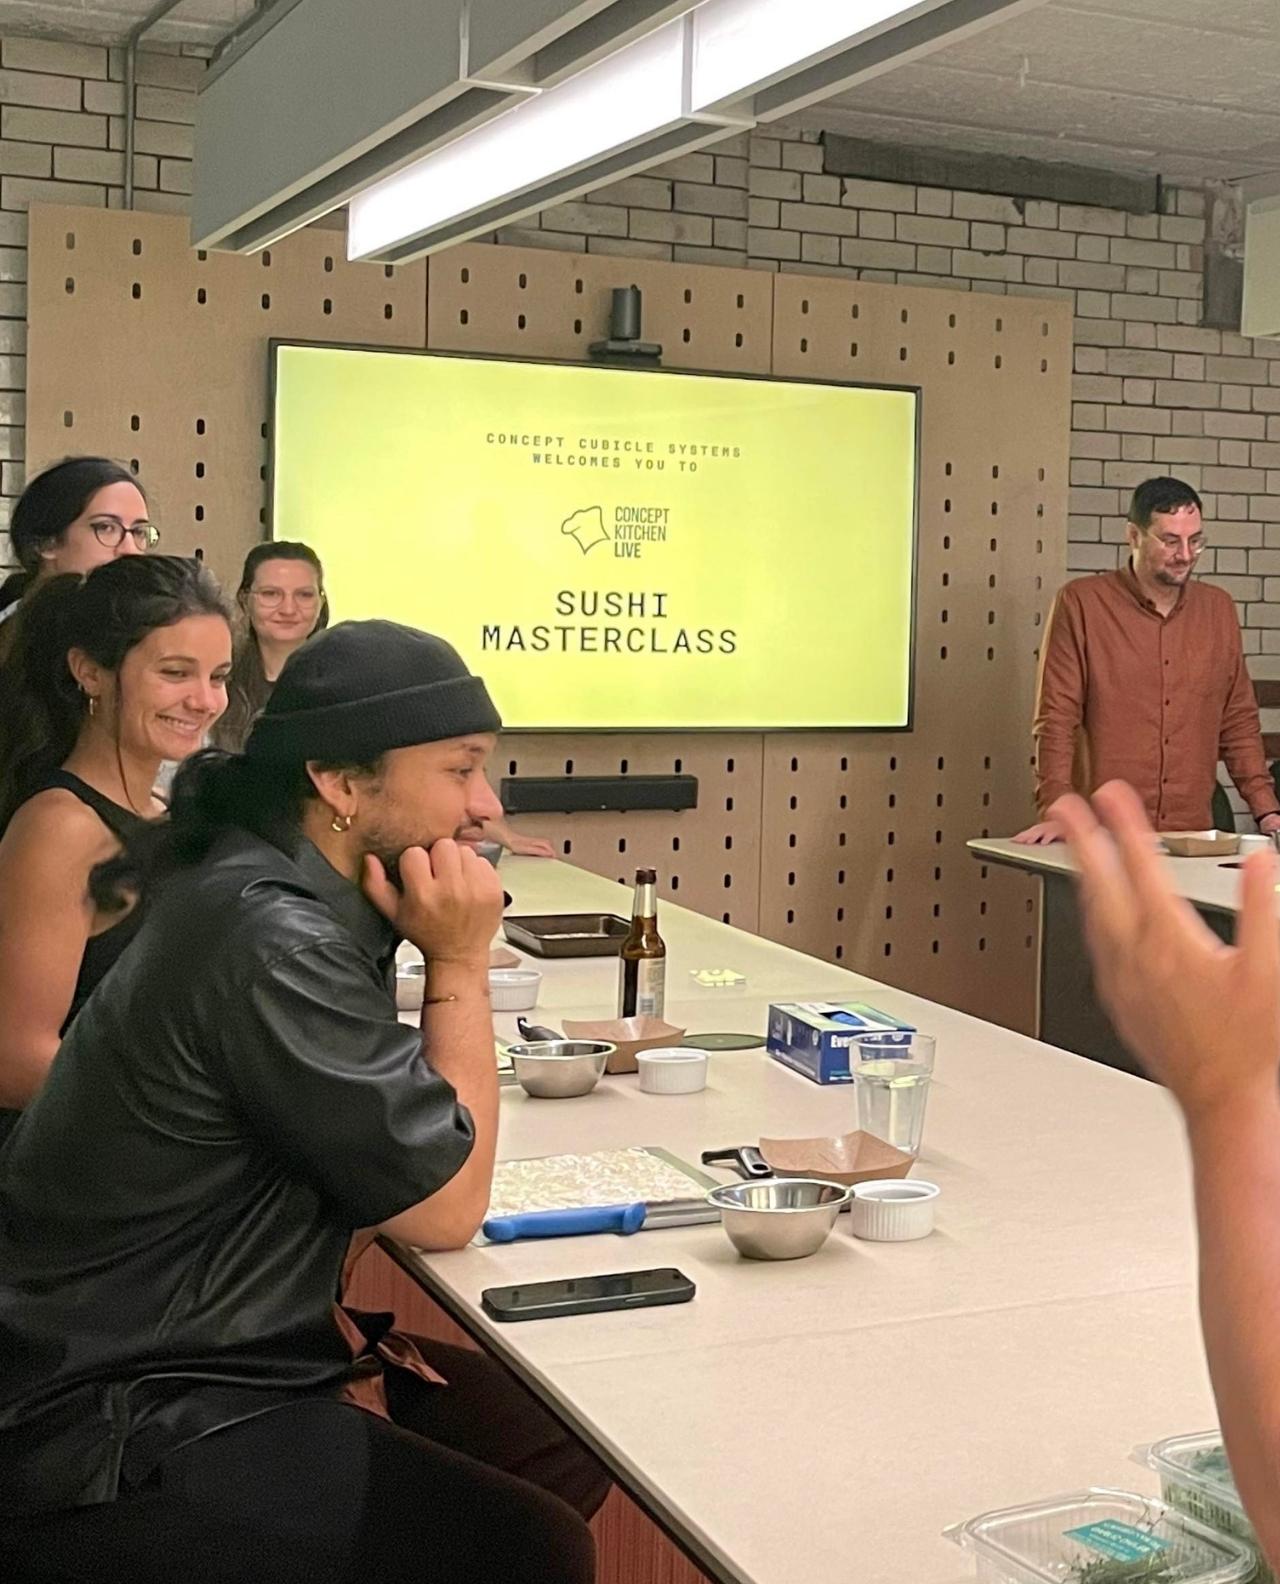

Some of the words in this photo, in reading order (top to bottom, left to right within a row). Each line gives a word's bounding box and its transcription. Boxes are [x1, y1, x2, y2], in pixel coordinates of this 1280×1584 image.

[487, 433, 564, 448] CONCEPT
[579, 438, 654, 453] CUBICLE
[669, 443, 741, 458] SYSTEMS
[533, 453, 621, 468] WELCOMES
[635, 459, 665, 470] YOU
[679, 461, 698, 472] TO
[615, 506, 670, 523] CONCEPT
[615, 525, 666, 541] KITCHEN
[614, 542, 641, 558] LIVE
[556, 591, 668, 618] SUSHI
[482, 625, 737, 653] MASTERCLASS
